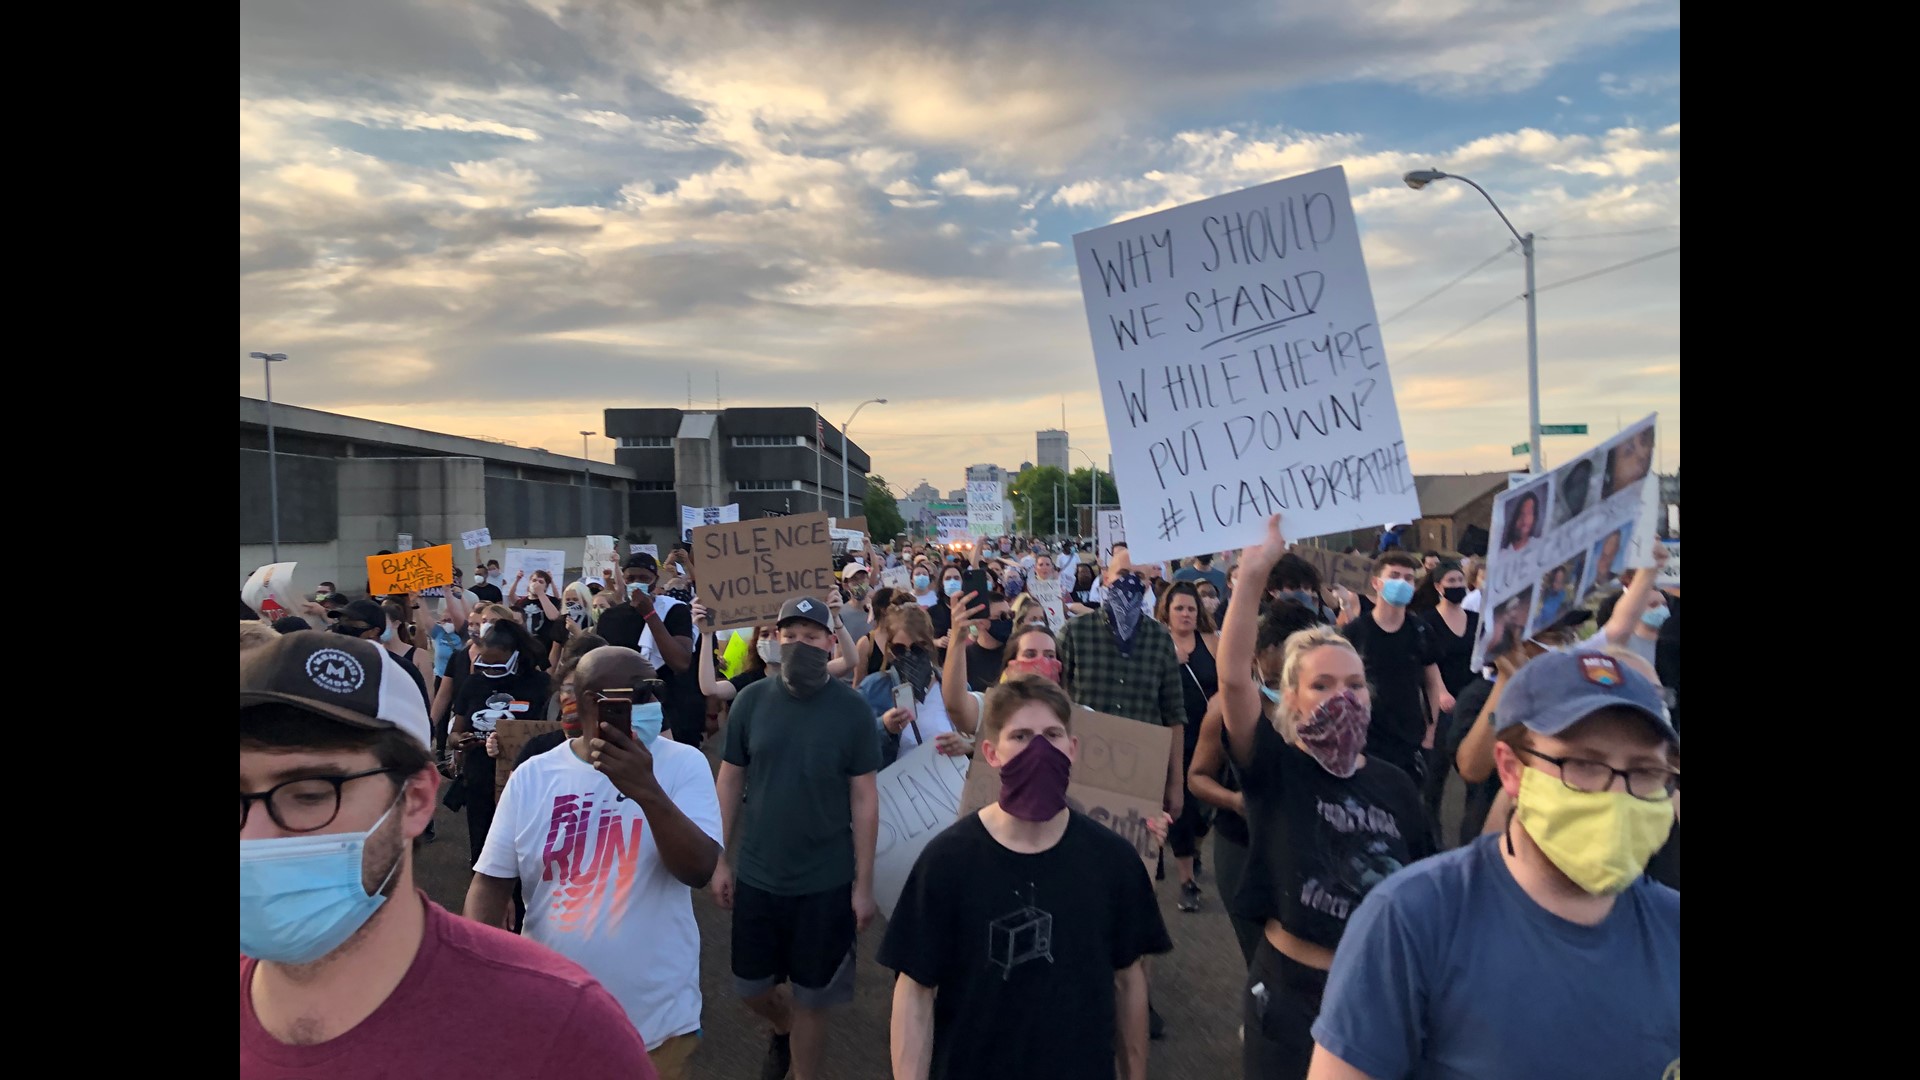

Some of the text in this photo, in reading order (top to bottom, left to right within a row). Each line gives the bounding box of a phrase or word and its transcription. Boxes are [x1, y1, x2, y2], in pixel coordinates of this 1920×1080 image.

[1091, 192, 1336, 297] WHY SHOULD
[1110, 303, 1166, 350] WE
[1149, 378, 1376, 489] PUT DOWN?
[704, 521, 826, 559] SILENCE
[381, 553, 432, 575] BLACK
[396, 566, 434, 582] LIVES
[753, 553, 775, 575] IS
[389, 573, 445, 592] MATTER
[709, 568, 831, 601] VIOLENCE
[326, 662, 345, 679] M
[542, 793, 643, 895] RUN
